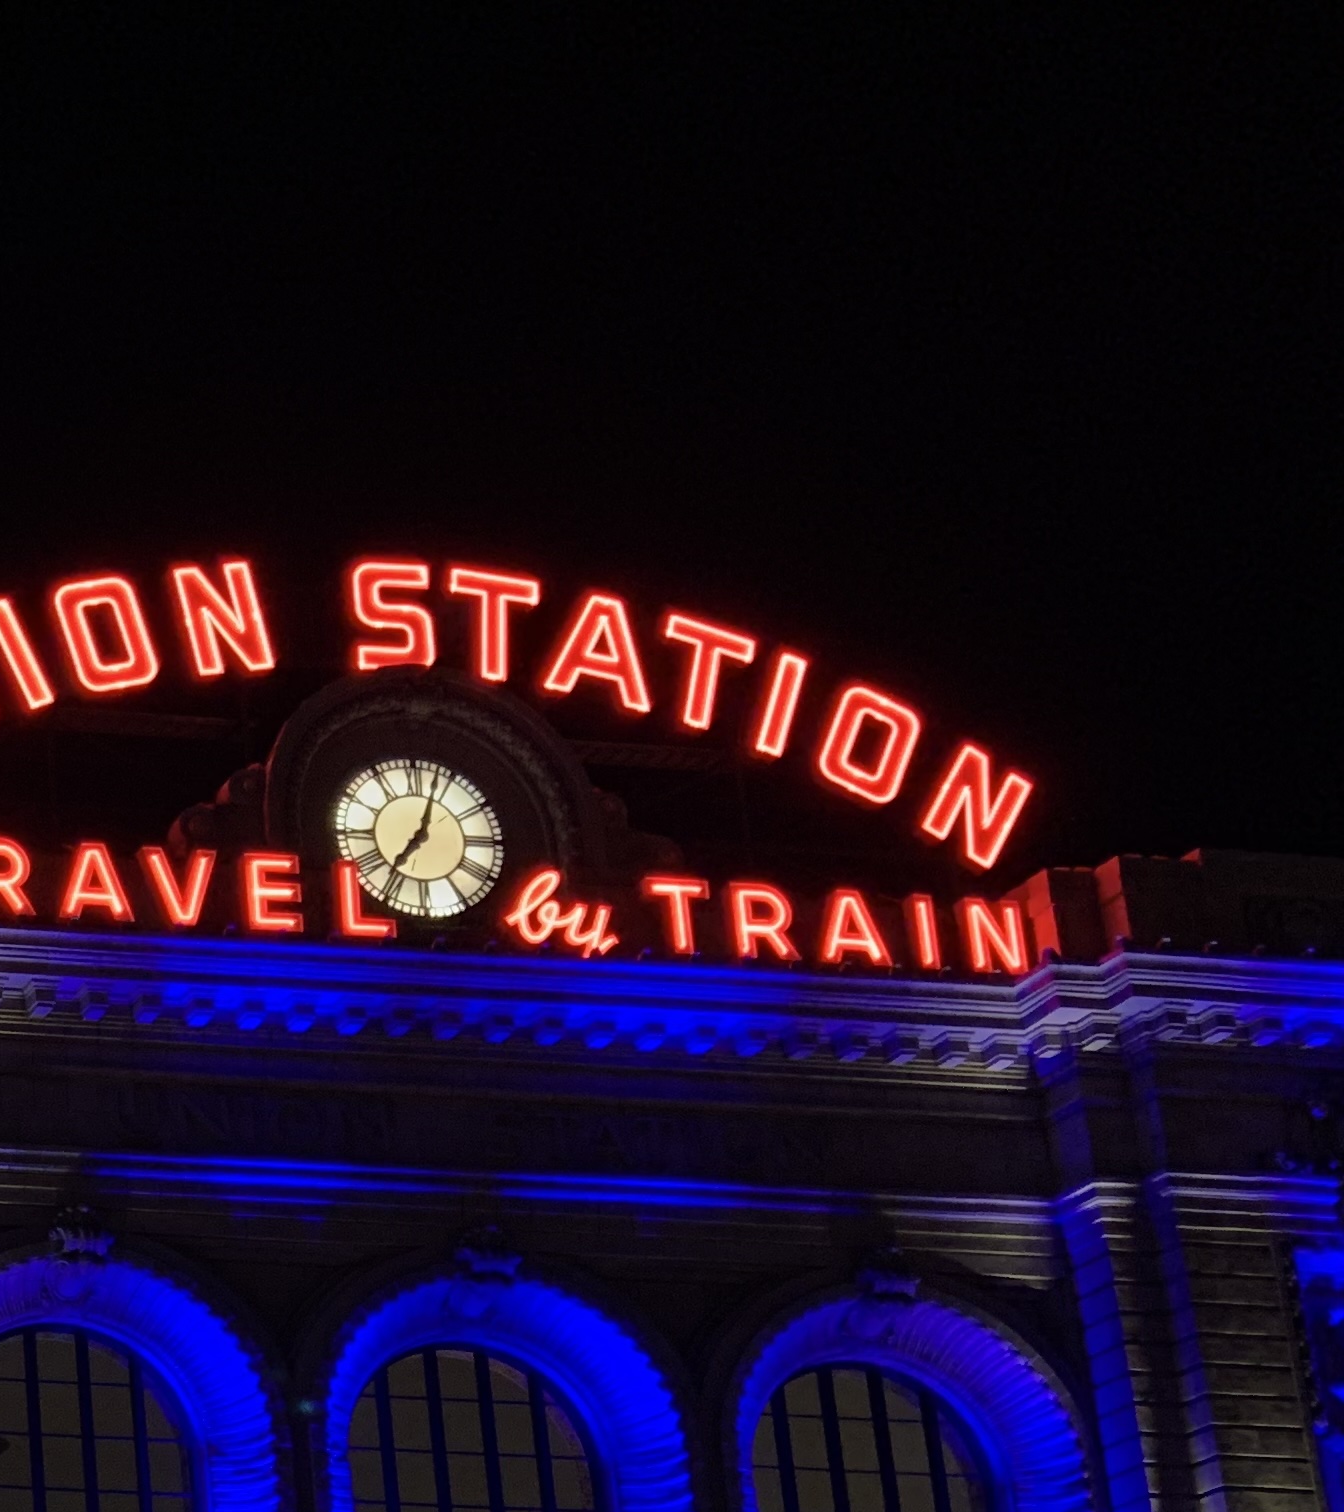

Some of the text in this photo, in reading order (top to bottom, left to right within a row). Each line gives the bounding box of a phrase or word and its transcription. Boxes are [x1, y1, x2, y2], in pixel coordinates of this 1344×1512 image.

[347, 557, 1035, 870] STATION
[504, 868, 620, 959] by
[642, 874, 1030, 976] TRAIN
